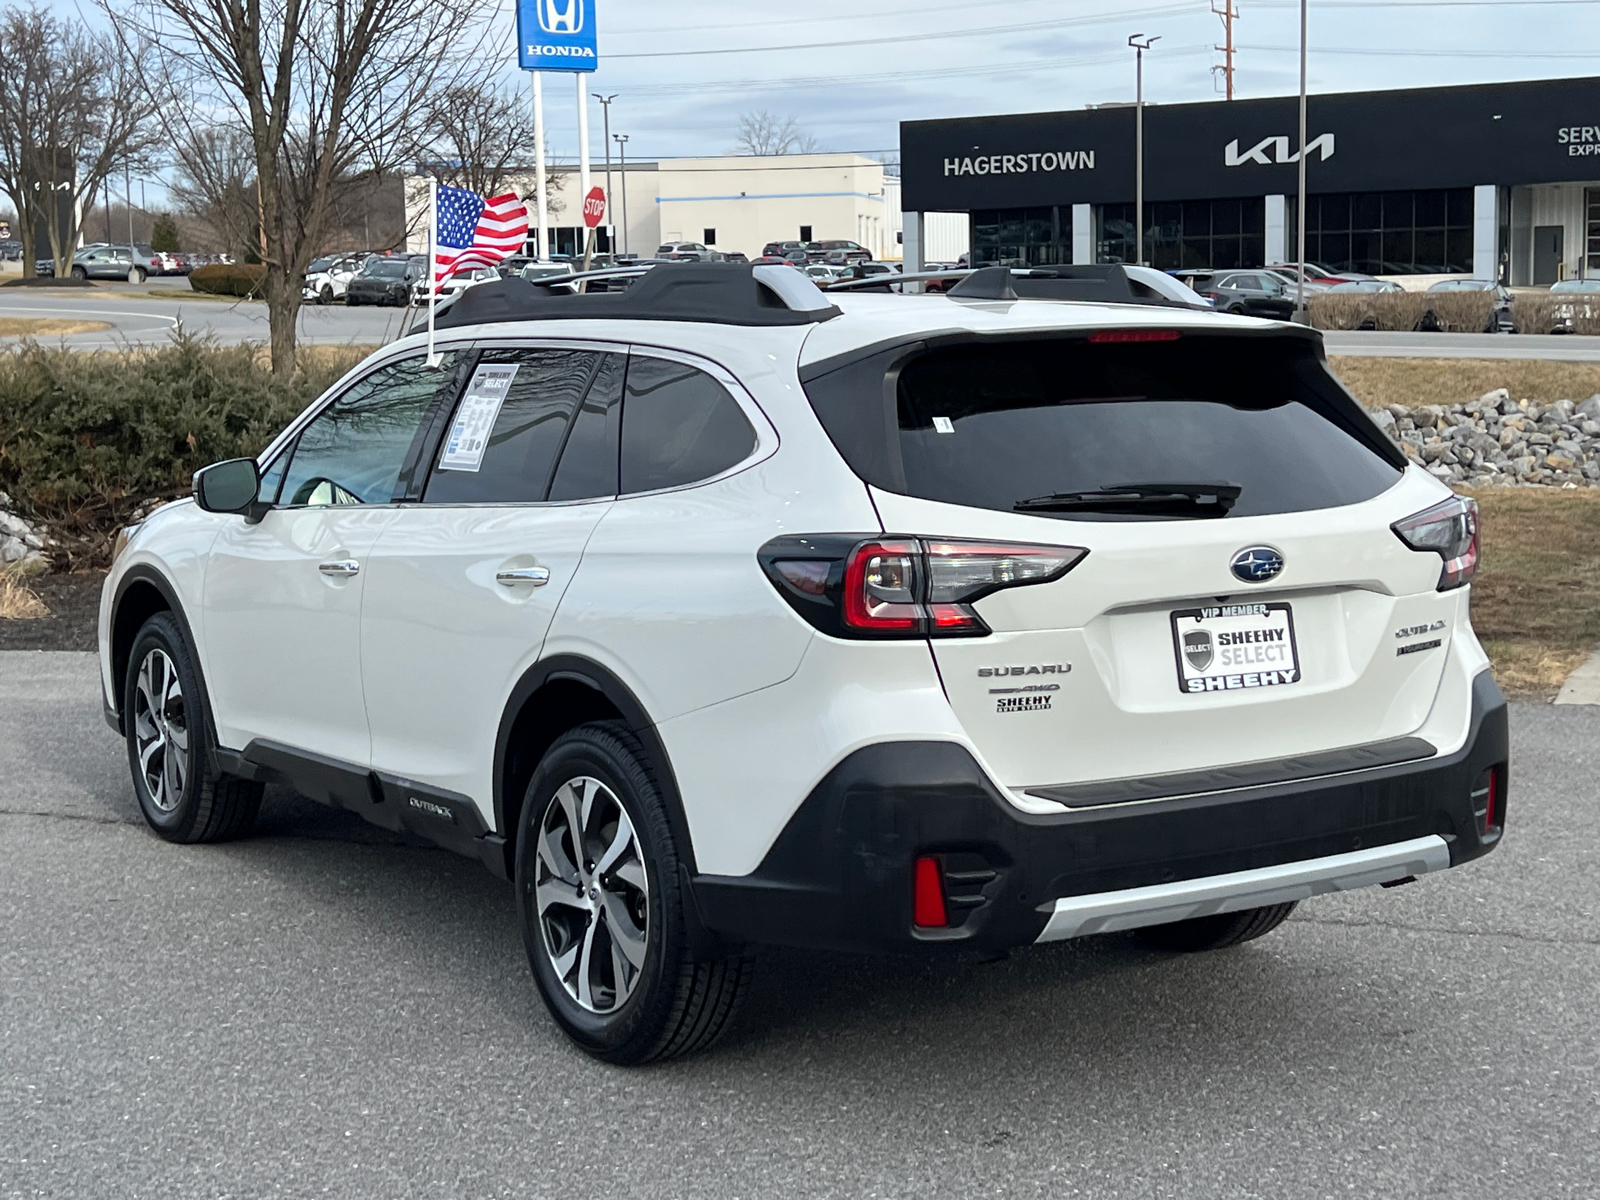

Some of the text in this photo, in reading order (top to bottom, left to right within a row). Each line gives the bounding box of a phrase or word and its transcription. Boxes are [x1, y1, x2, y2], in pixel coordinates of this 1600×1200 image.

[526, 45, 595, 58] HONDA
[944, 150, 1095, 176] HAGERSTOWN
[584, 198, 605, 217] STOP
[1201, 604, 1267, 618] VIP MEMBER
[1218, 628, 1284, 646] SHEEHY
[1186, 643, 1211, 653] SELECT
[1221, 644, 1287, 666] SELECT
[978, 663, 1072, 677] SUBARU
[1187, 669, 1297, 693] SHEEHY
[997, 695, 1052, 707] SHEEHY
[409, 797, 452, 818] OUTBACK
